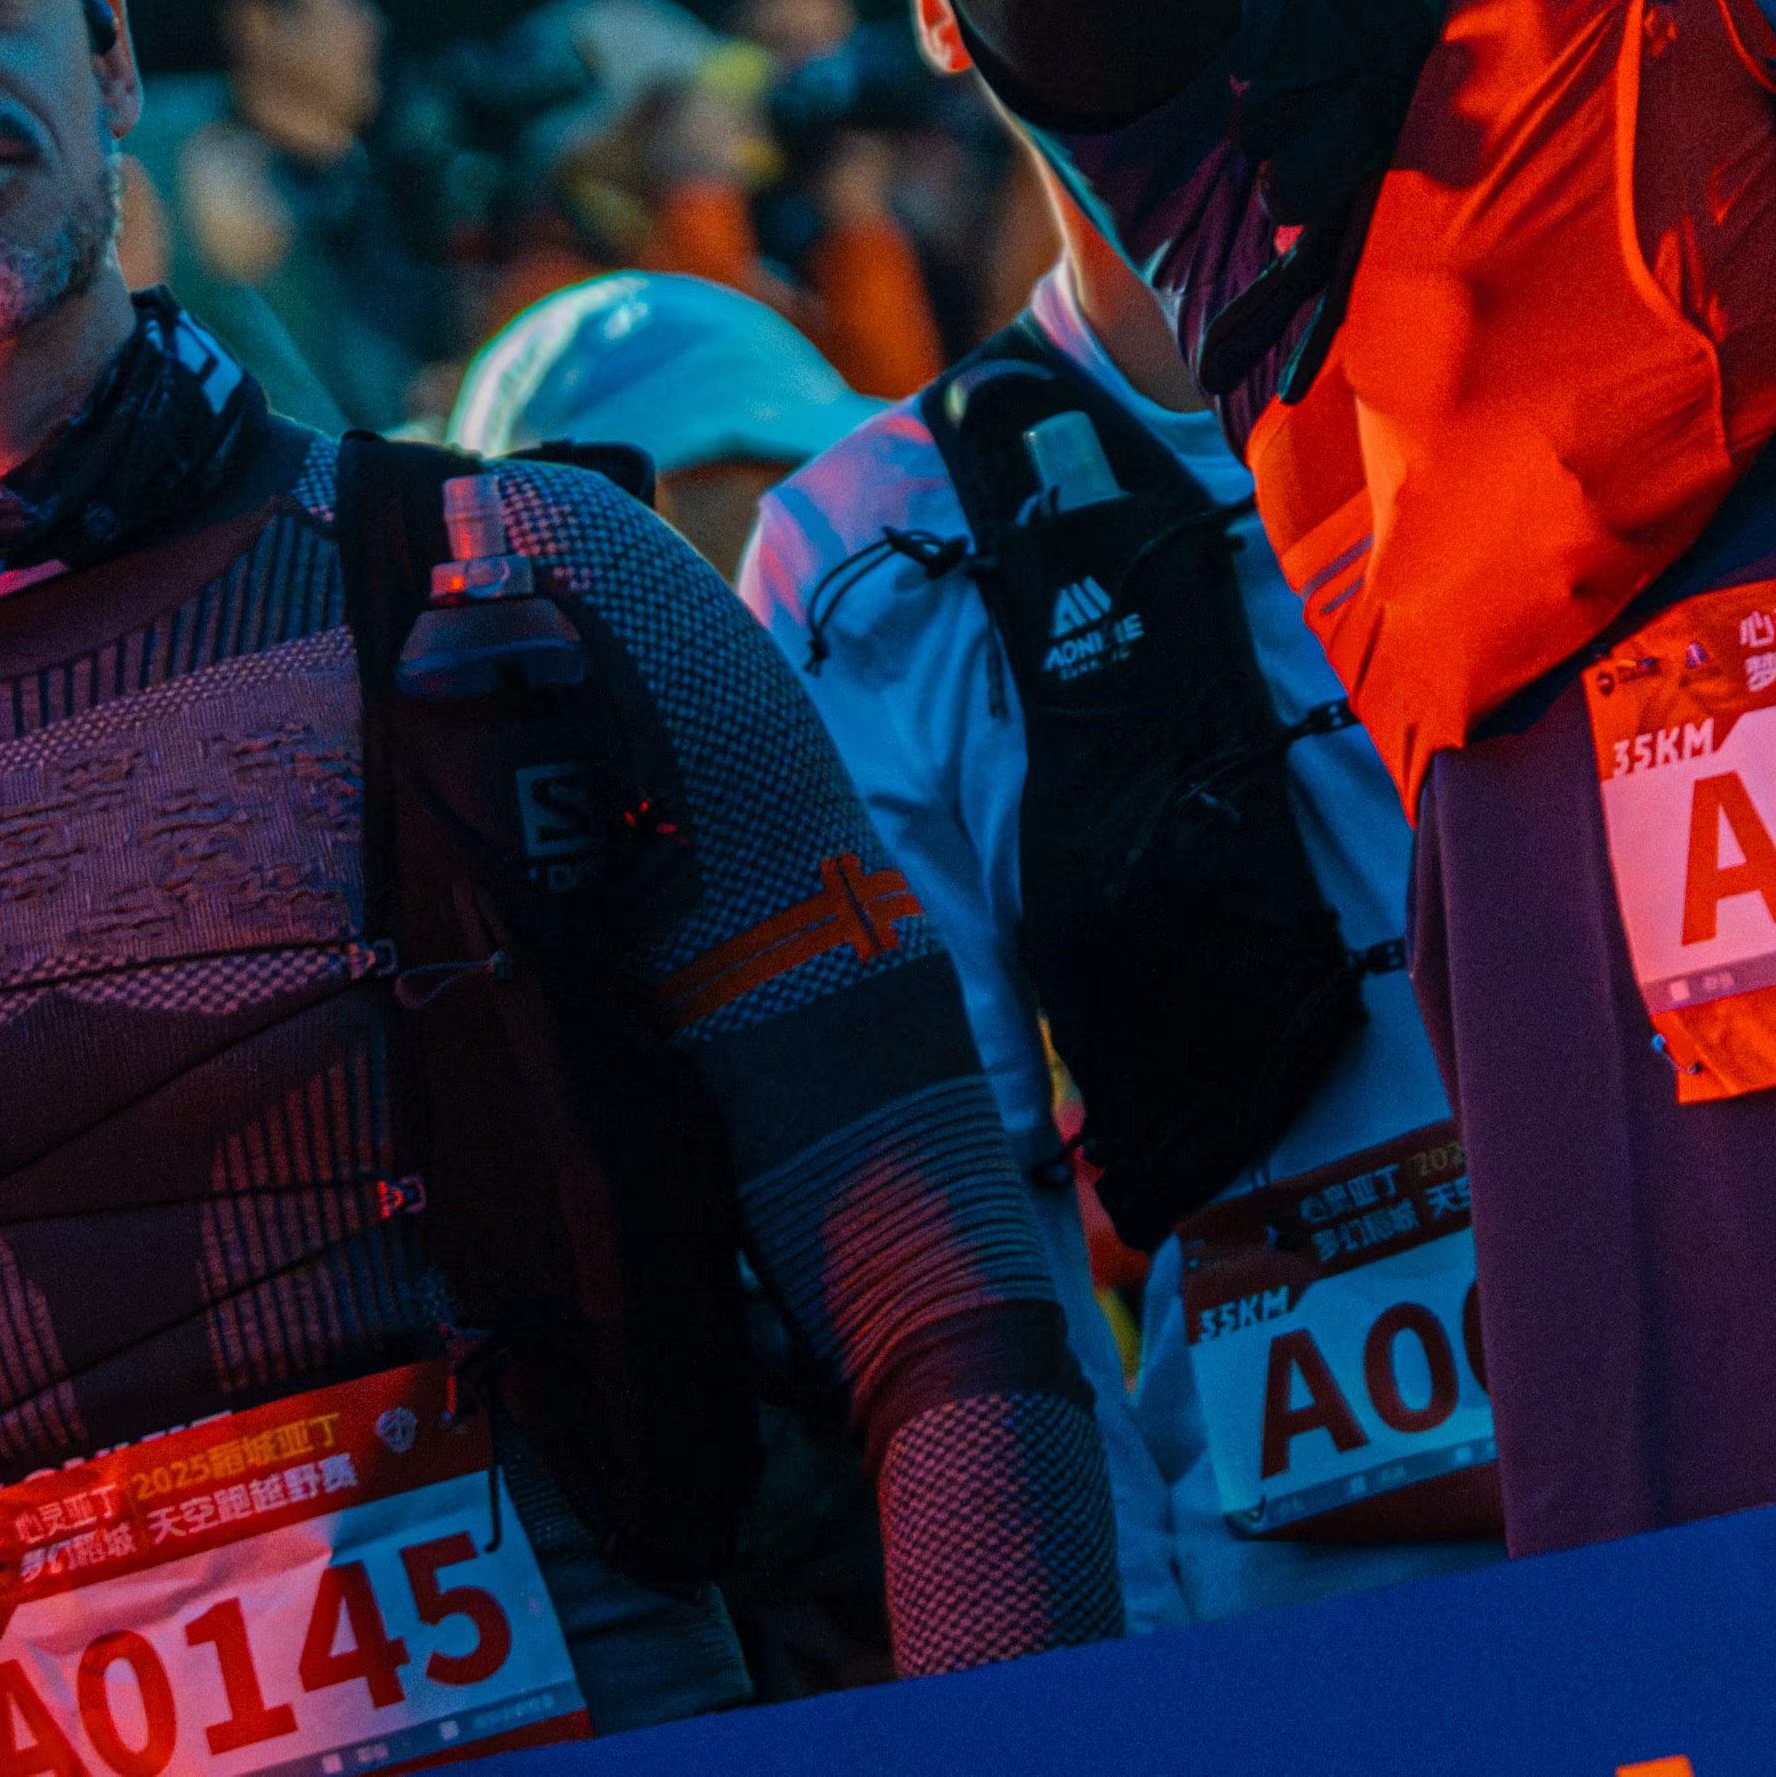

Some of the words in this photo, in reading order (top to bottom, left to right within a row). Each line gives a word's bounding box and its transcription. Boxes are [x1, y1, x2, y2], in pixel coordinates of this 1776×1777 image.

[1043, 612, 1145, 671] AONIIE
[1611, 717, 1715, 780] 35KM
[146, 1452, 359, 1546] 天空跑越野赛
